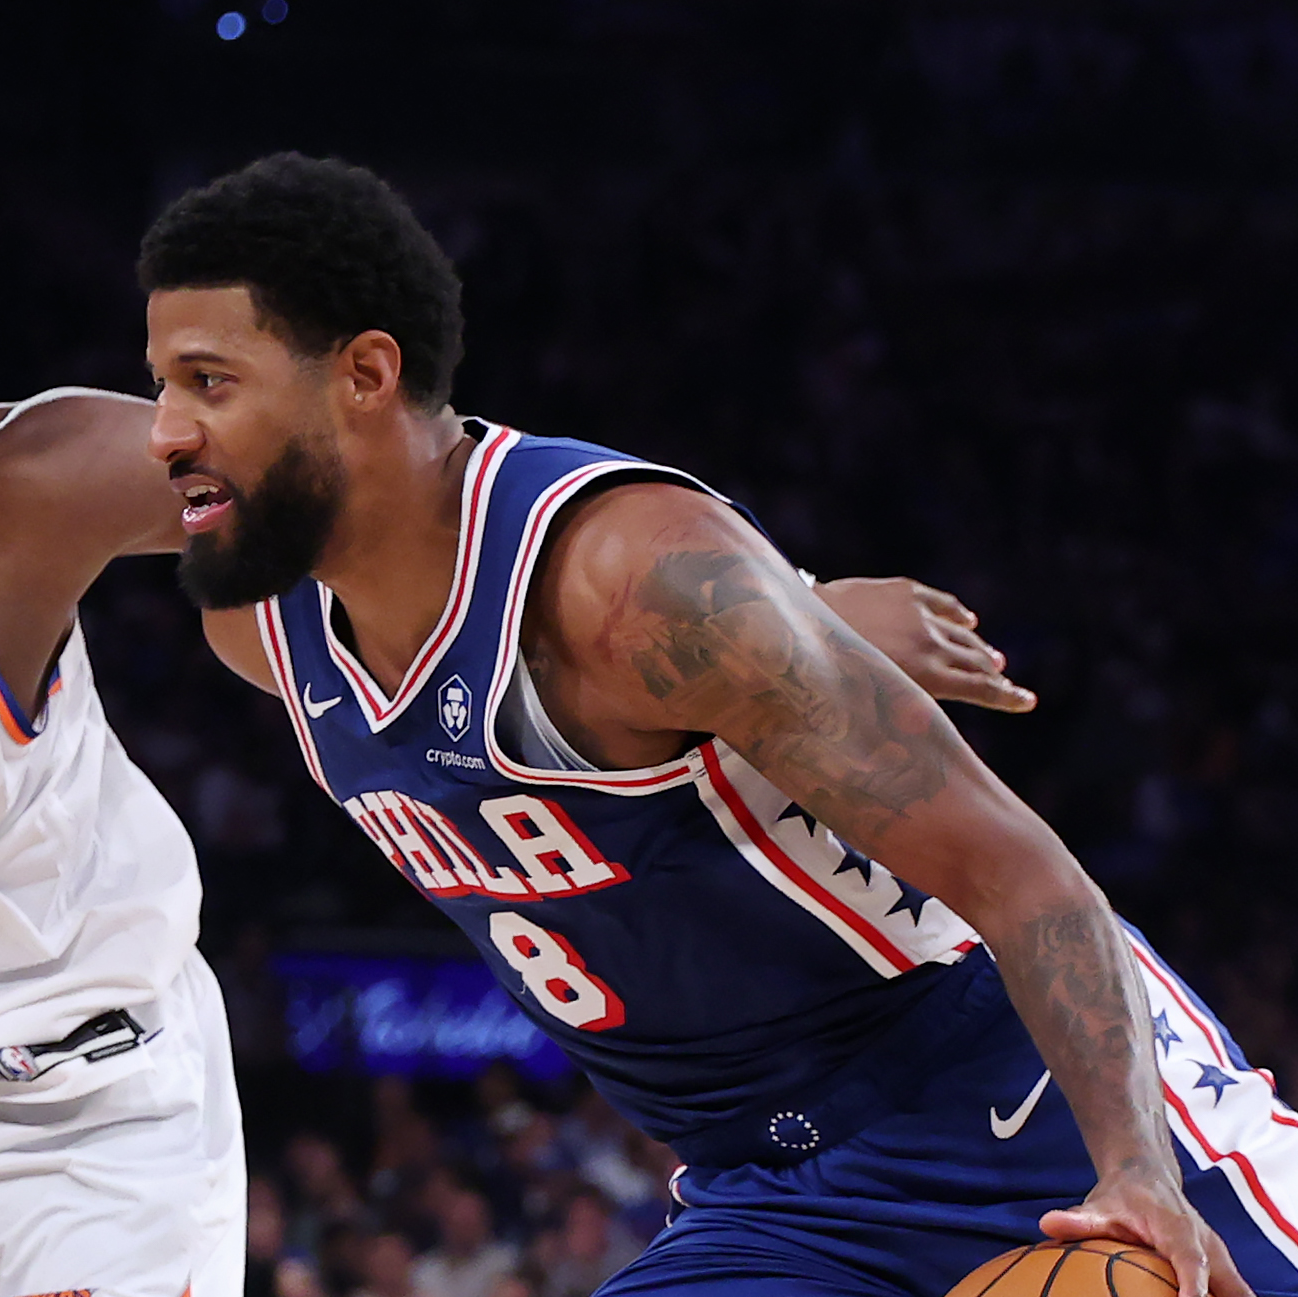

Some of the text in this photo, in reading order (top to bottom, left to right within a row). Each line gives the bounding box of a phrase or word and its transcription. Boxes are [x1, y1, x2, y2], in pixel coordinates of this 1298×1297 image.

[426, 748, 486, 770] crypto.com
[342, 790, 631, 901] PHILA
[489, 911, 625, 1032] 8
